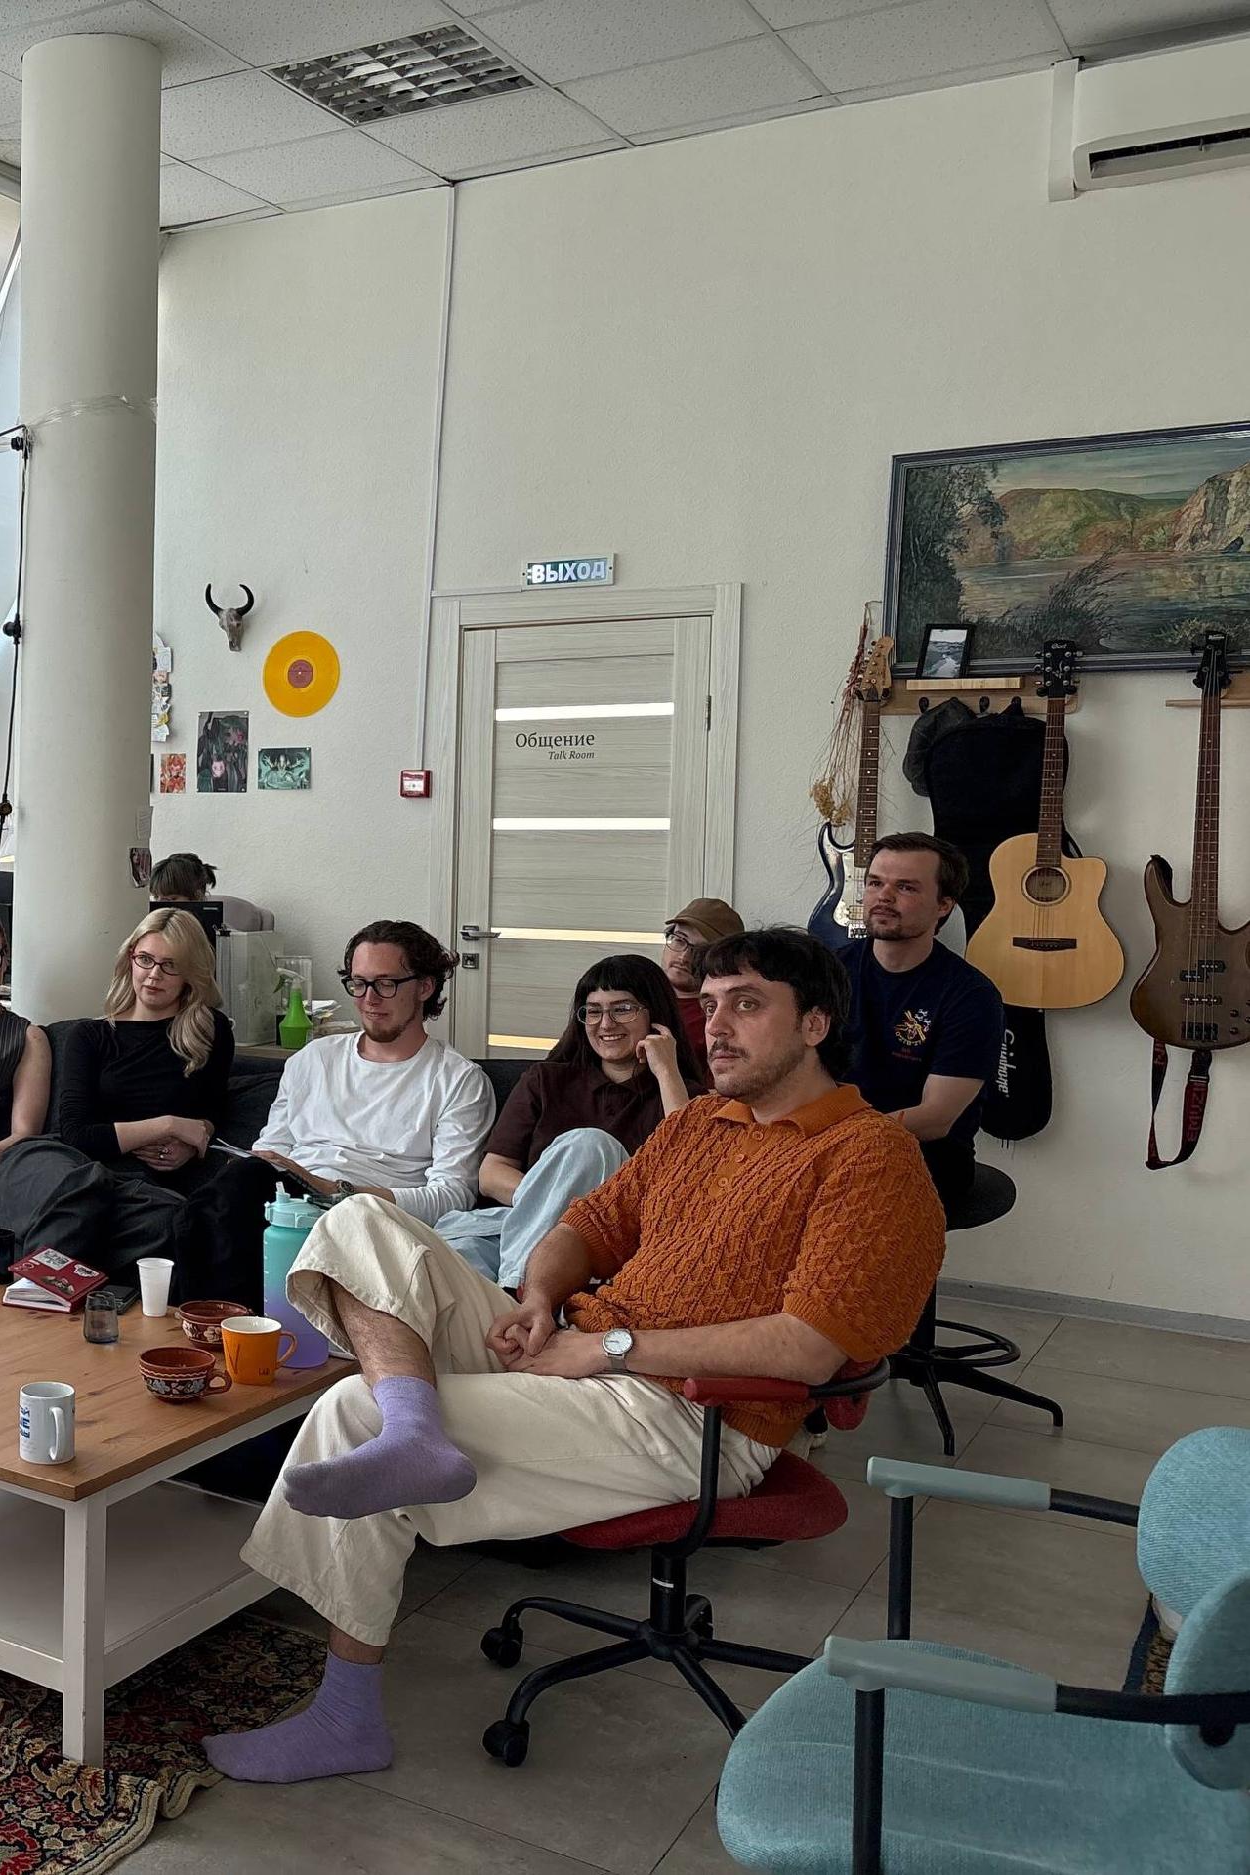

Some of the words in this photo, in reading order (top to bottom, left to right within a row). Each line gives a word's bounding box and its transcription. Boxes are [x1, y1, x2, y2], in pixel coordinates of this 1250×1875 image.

[531, 561, 605, 584] ВЫХОД
[515, 732, 595, 749] Общение
[548, 750, 567, 760] Talk
[568, 750, 595, 760] Room
